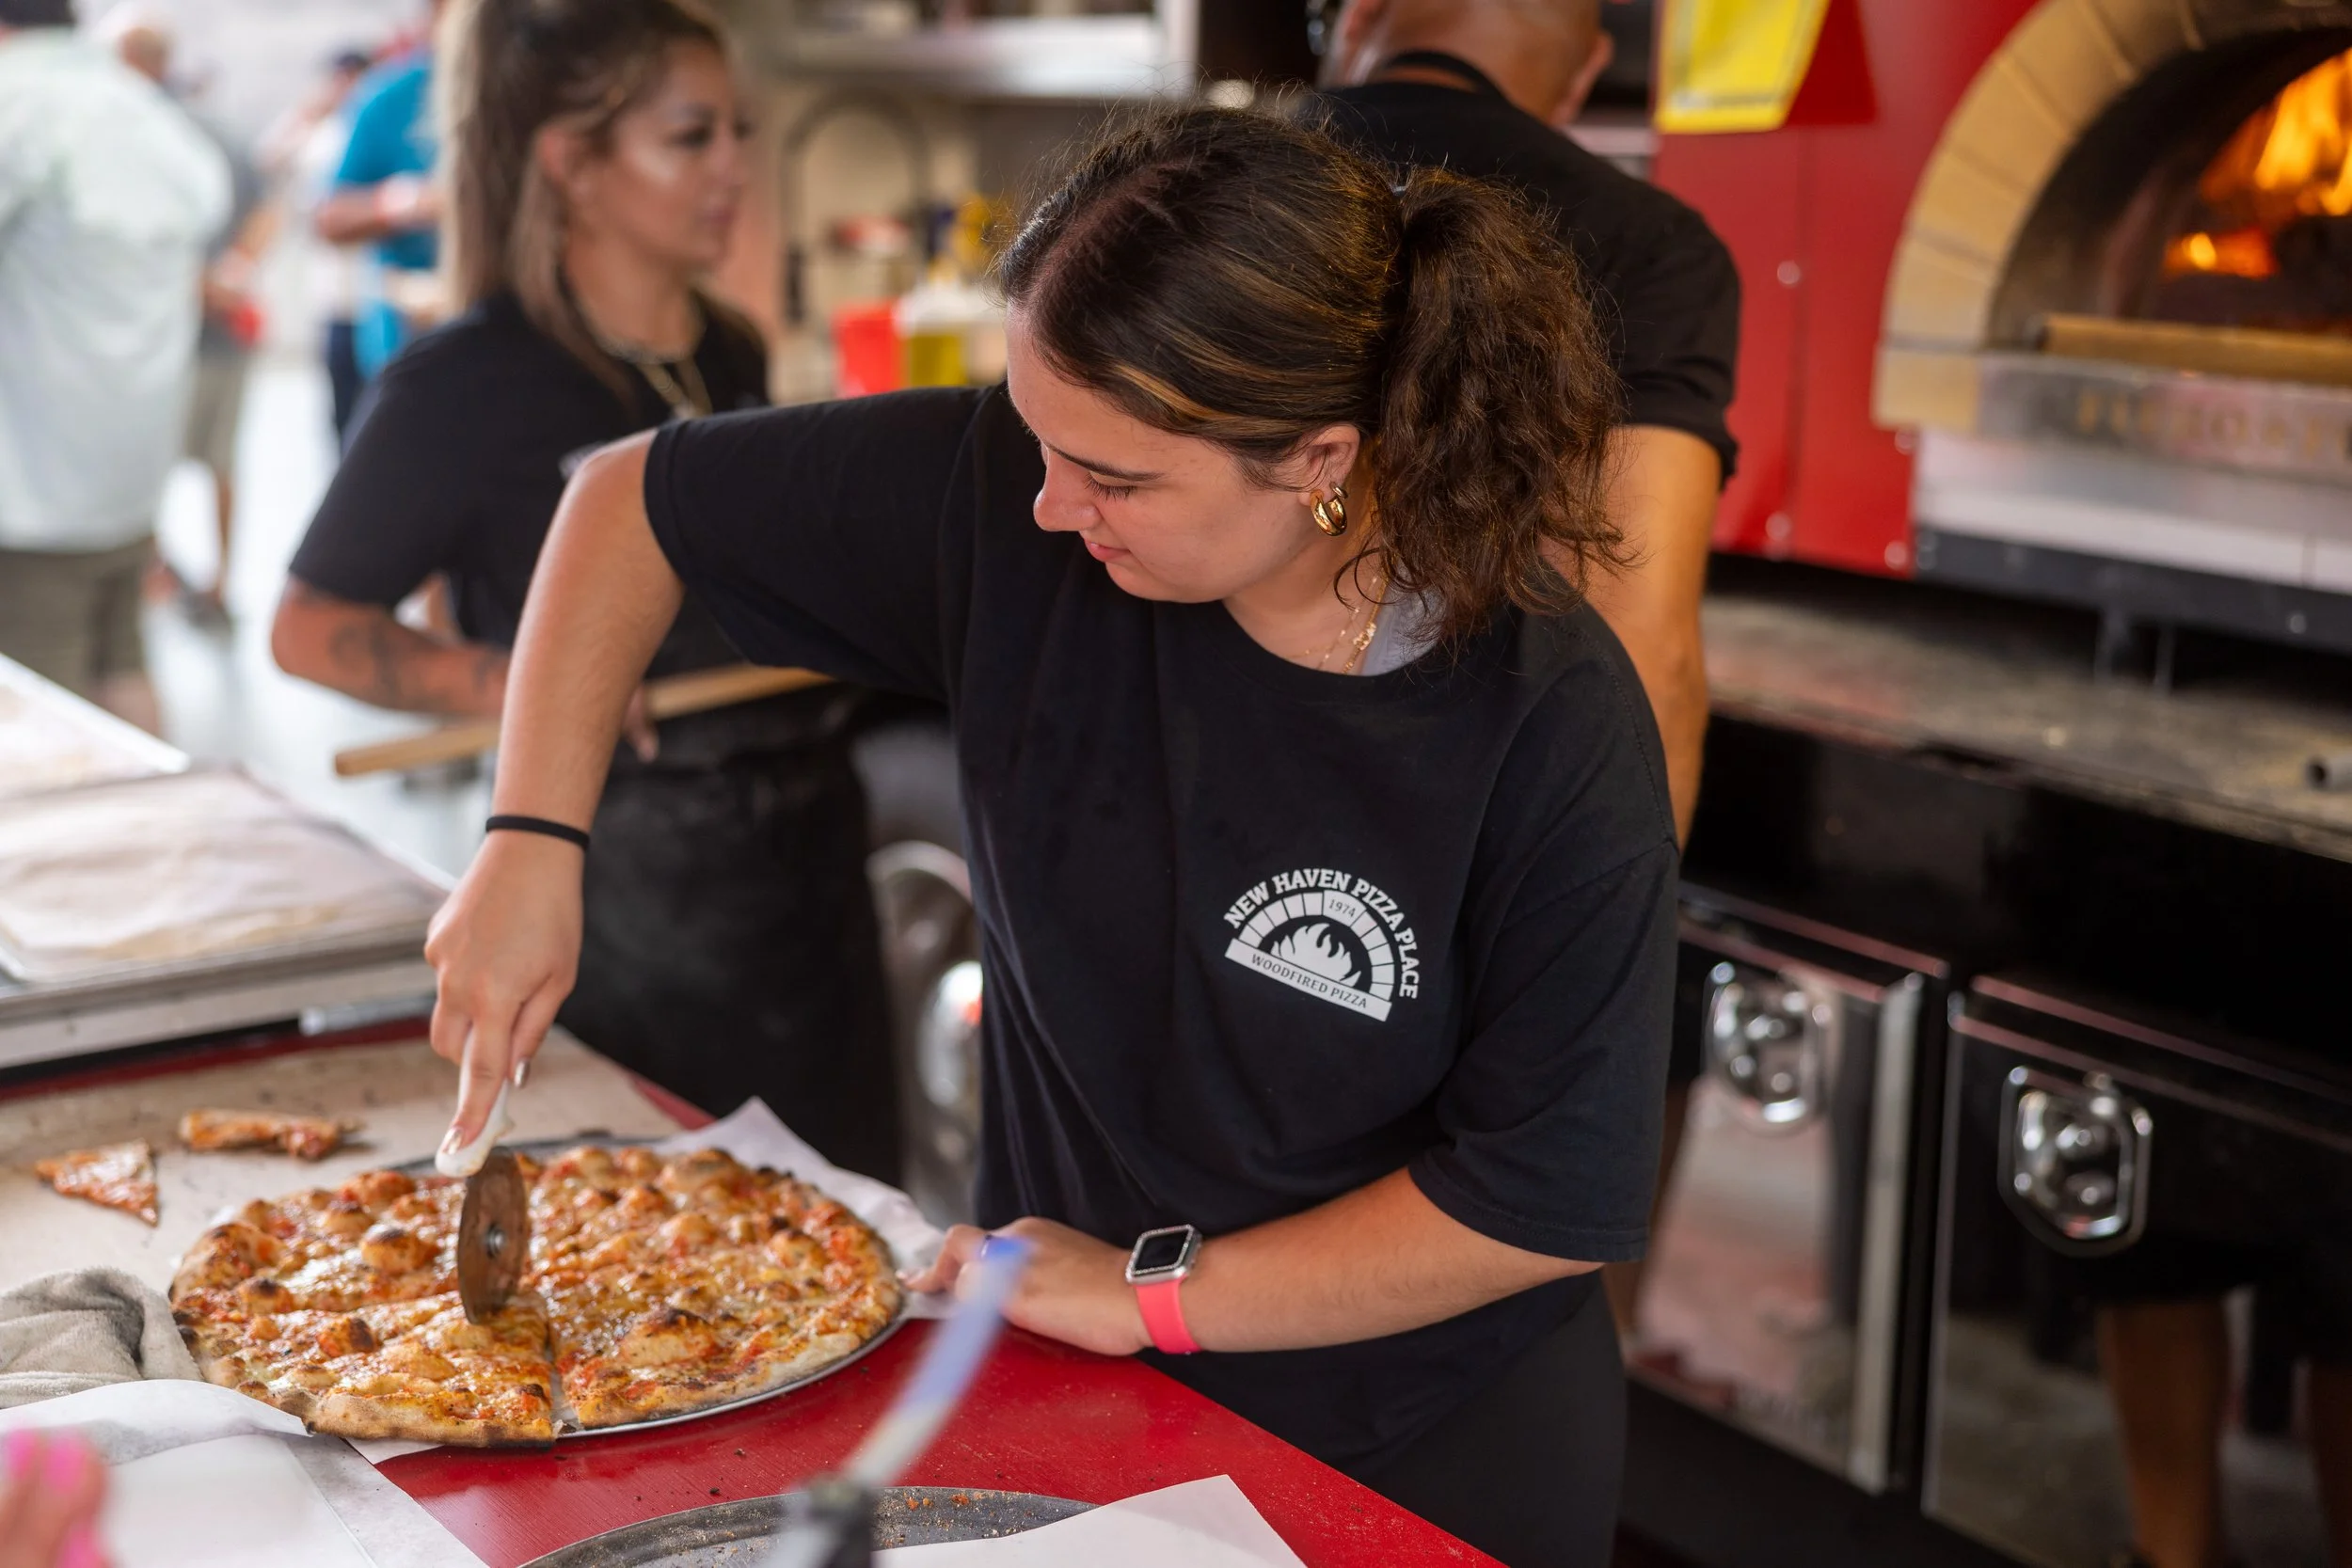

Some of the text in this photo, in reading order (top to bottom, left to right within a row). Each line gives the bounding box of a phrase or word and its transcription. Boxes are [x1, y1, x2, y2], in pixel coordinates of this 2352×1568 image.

[1224, 868, 1420, 999] NEW HAVEN PIZZA PLACE
[1328, 898, 1357, 918] 1974
[1251, 953, 1368, 1008] WOODFIRED PIZZA
